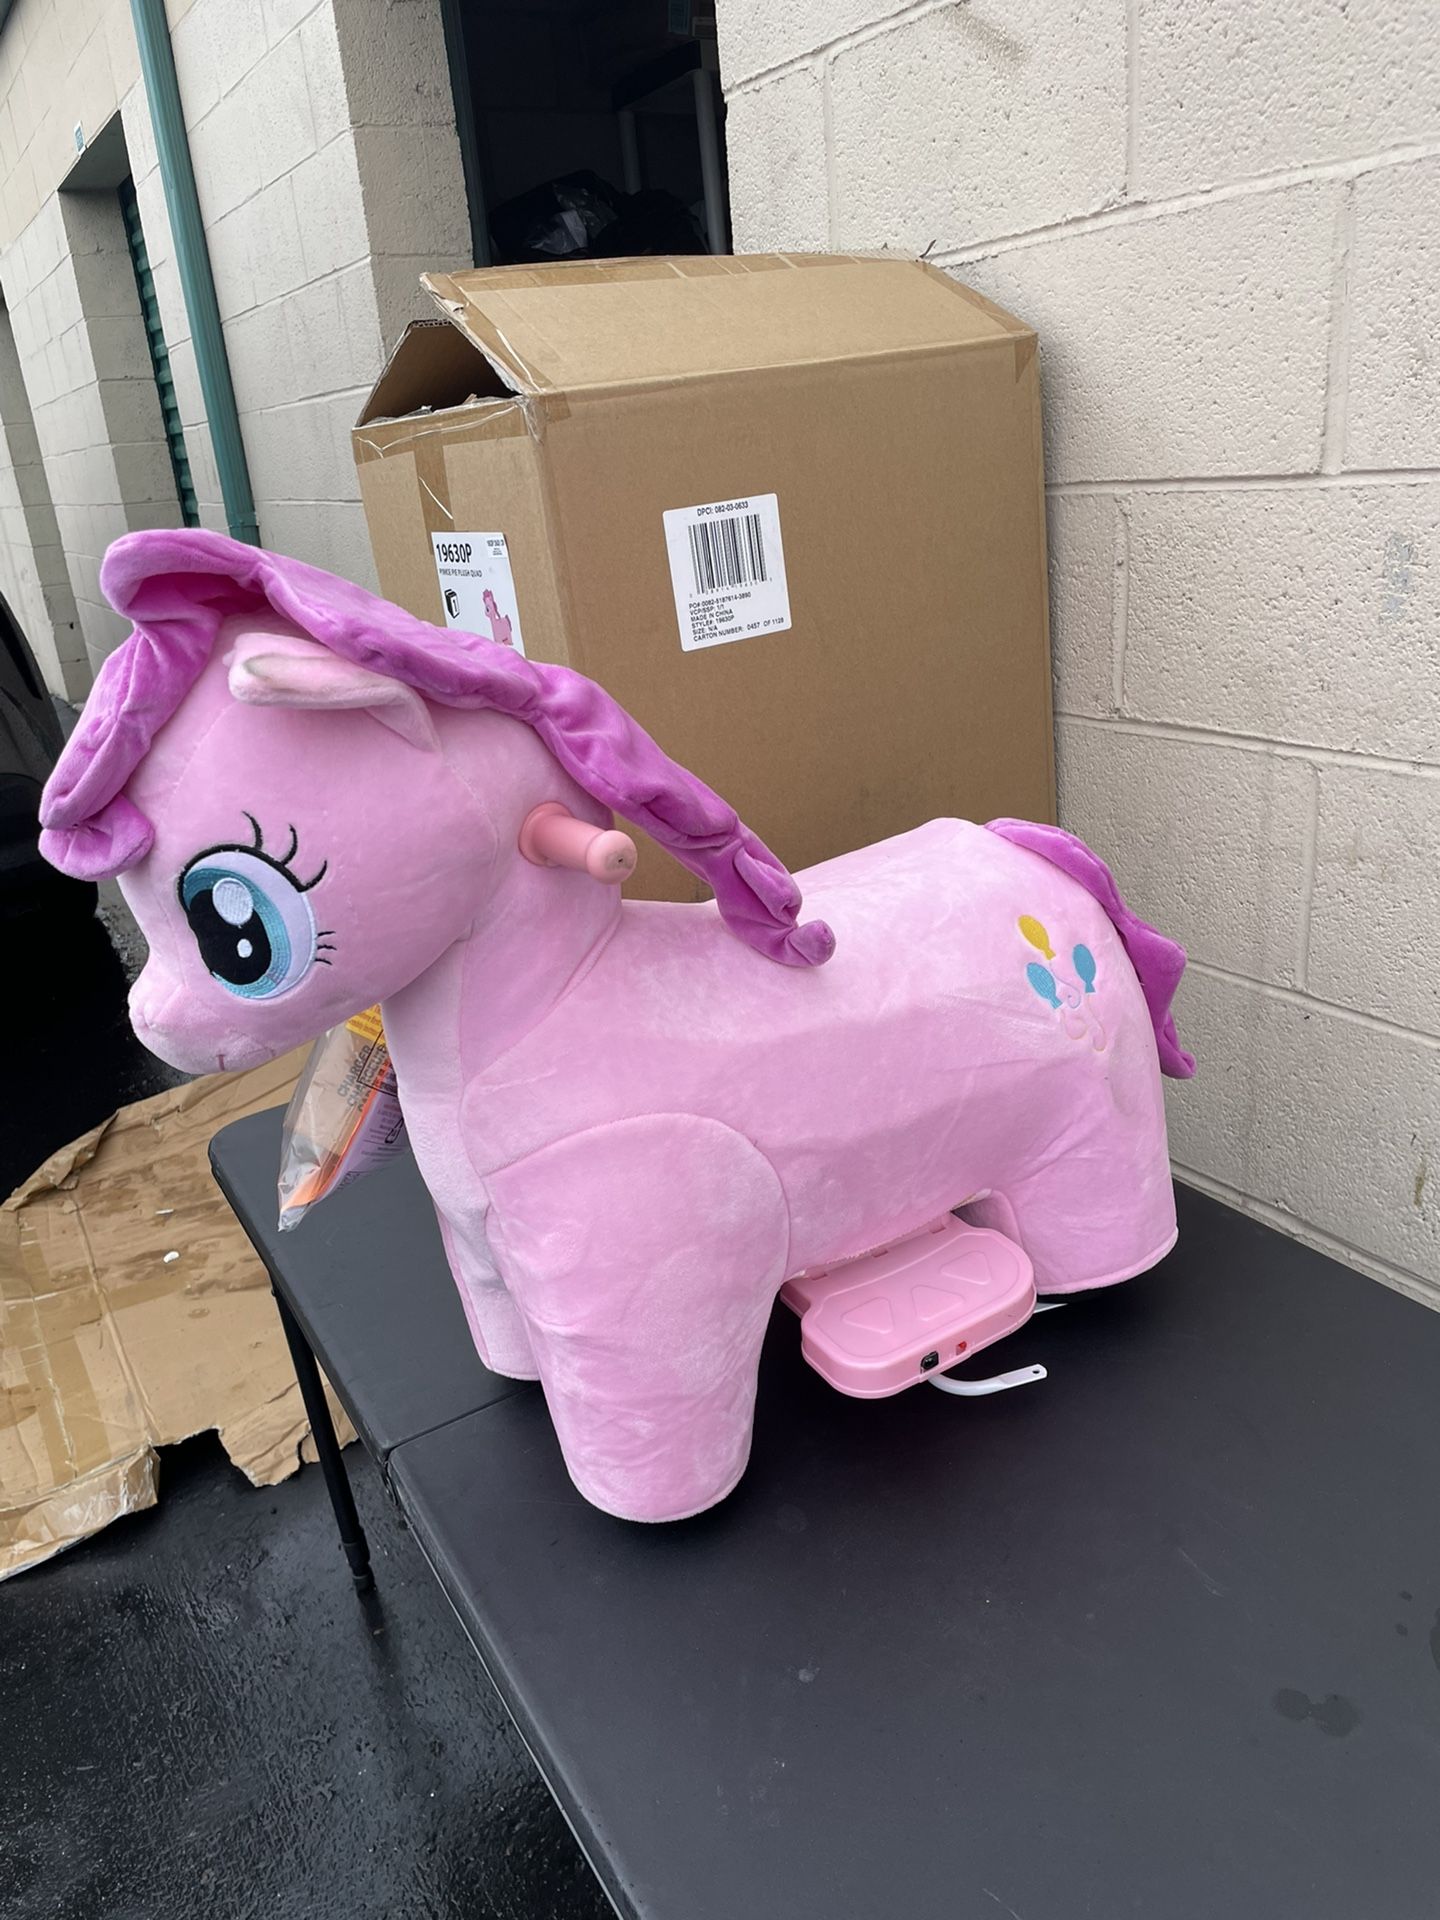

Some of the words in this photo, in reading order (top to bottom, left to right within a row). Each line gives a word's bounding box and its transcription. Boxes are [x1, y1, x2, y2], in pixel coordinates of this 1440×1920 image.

[697, 506, 714, 517] DPCI:
[715, 501, 749, 514] 082-03-0633
[436, 543, 472, 563] 19630P
[689, 601, 701, 609] PO#
[690, 613, 708, 622] MADE
[715, 609, 733, 618] CHINA
[691, 619, 715, 629] STYLE#:
[692, 626, 708, 635] SIZE:
[693, 632, 718, 642] CARTON
[718, 626, 744, 637] NUMBER:
[747, 622, 760, 631] 0457
[763, 619, 772, 627] OF
[772, 617, 784, 625] 1128
[337, 1045, 372, 1097] CHARGER
